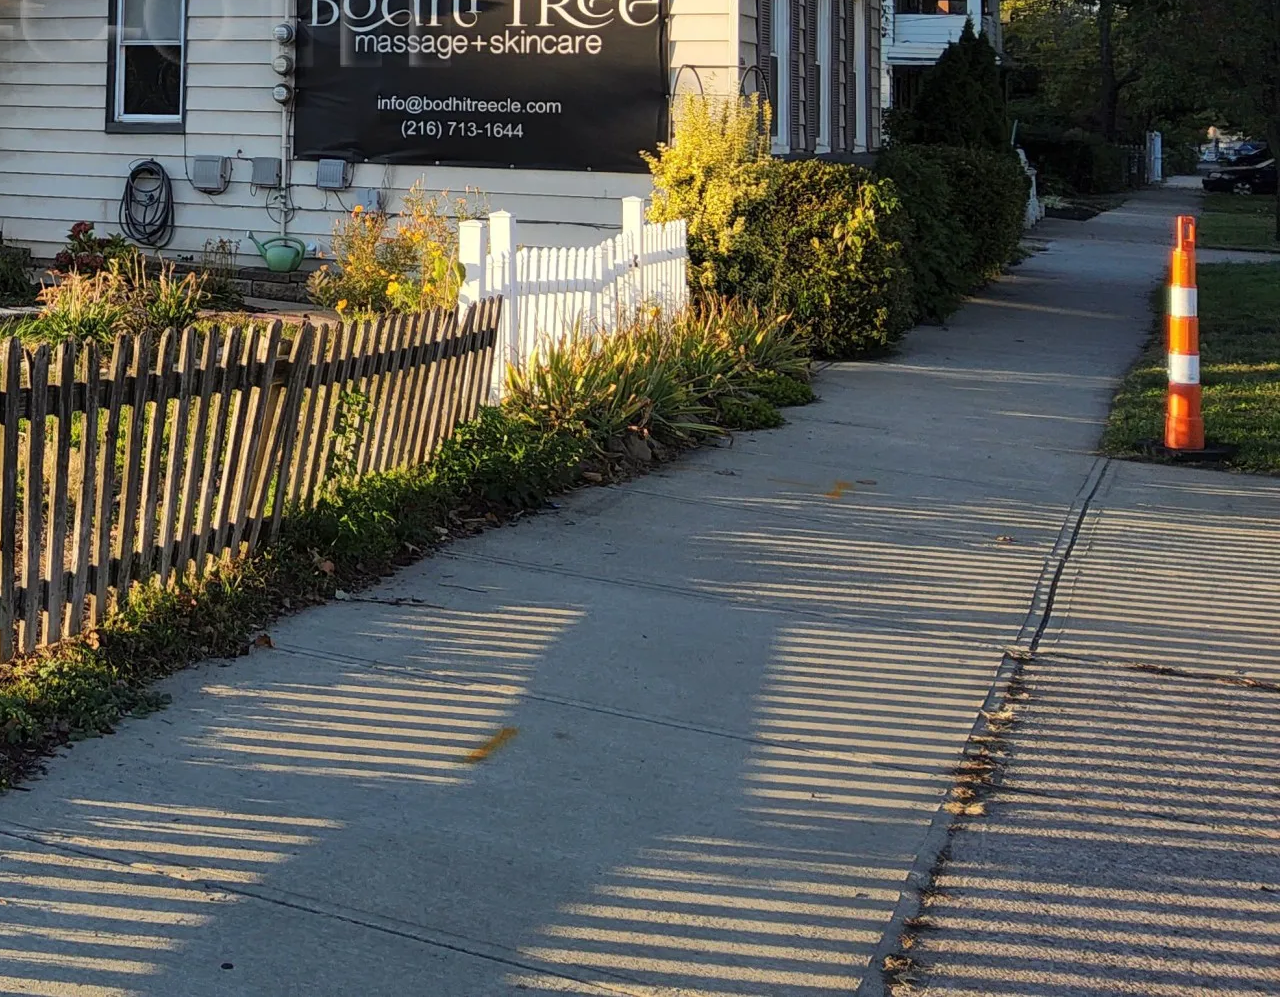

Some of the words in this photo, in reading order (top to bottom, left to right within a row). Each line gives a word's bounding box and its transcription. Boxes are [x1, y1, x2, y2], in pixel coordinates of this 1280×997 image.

[354, 29, 602, 59] massage+skincare
[377, 95, 562, 115] info@bodhitreecle.com
[401, 120, 443, 139] (216)
[447, 122, 524, 139] 713-1644
